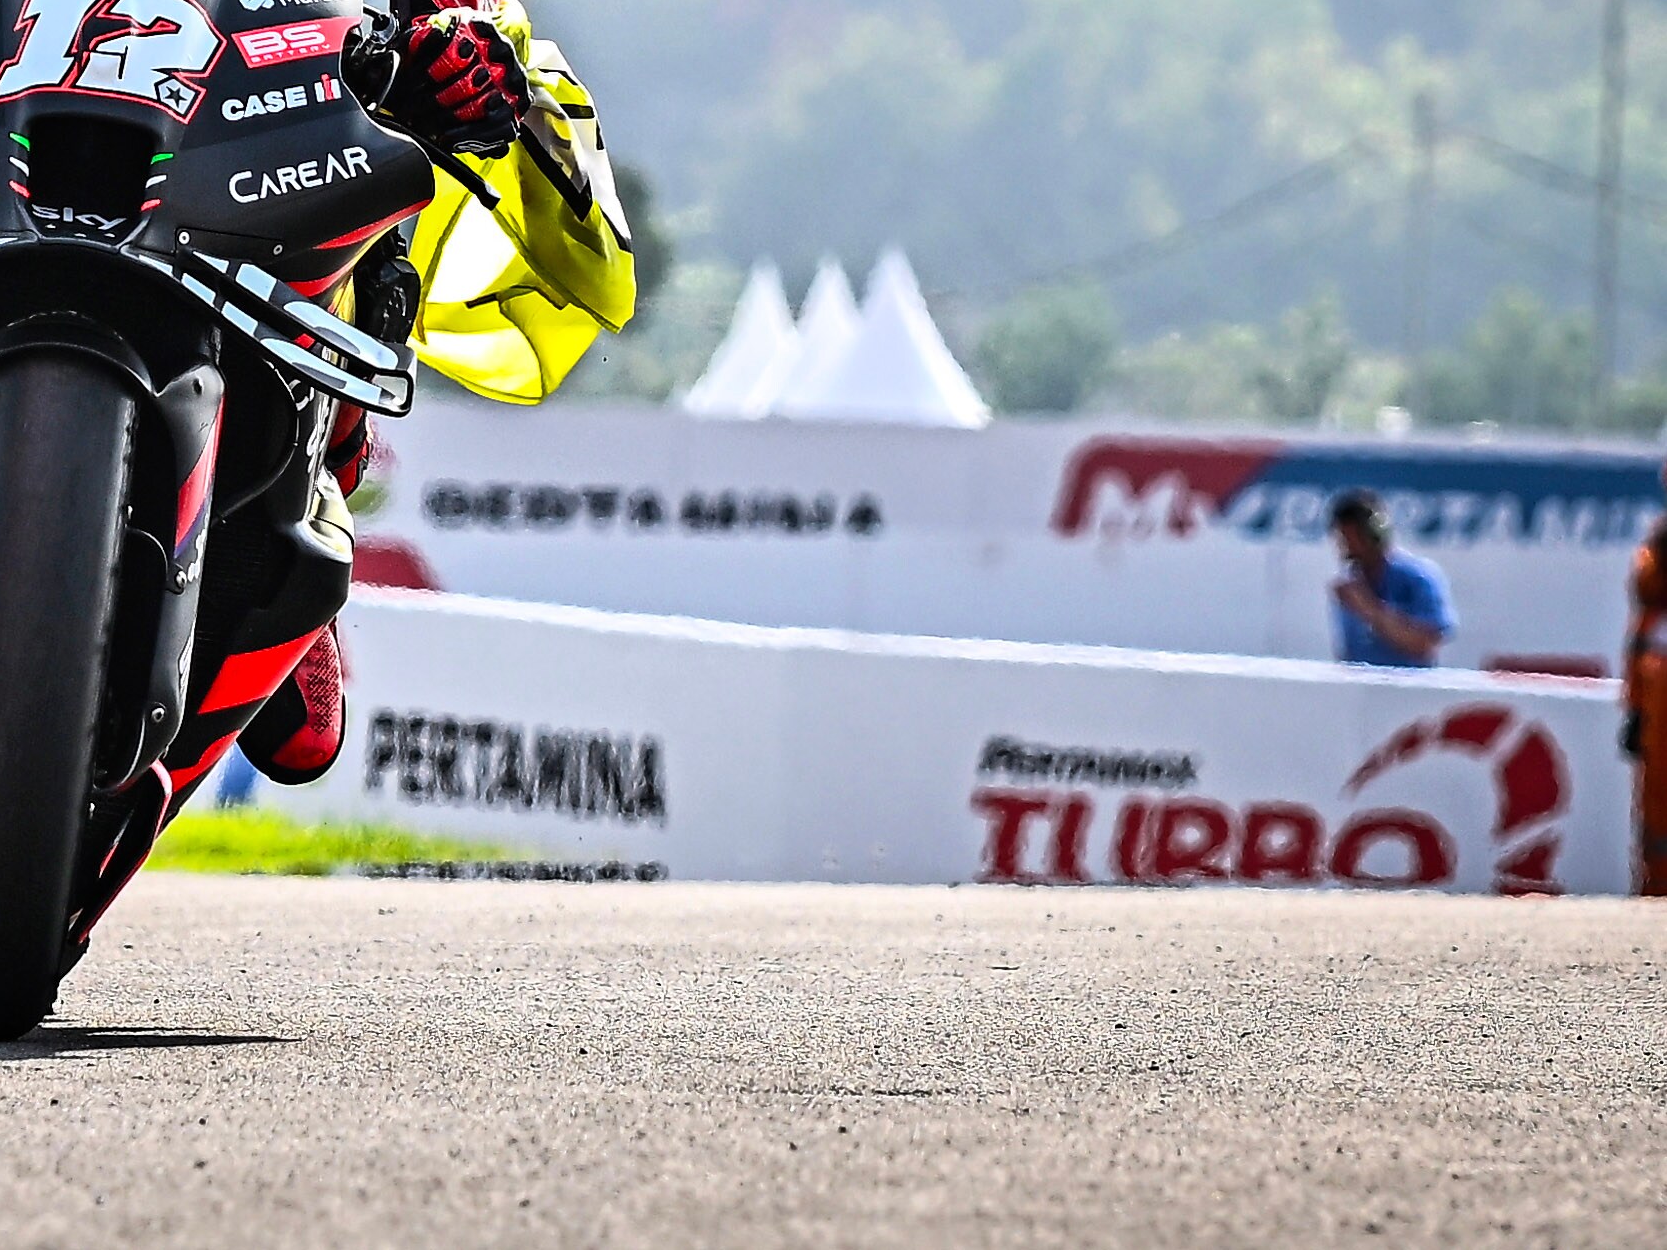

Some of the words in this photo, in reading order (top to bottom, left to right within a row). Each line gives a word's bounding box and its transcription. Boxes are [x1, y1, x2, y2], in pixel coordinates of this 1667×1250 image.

[239, 24, 326, 57] BS
[221, 85, 308, 121] CASE
[229, 146, 372, 203] CAREAR
[365, 710, 667, 828] PERTAMINA
[973, 788, 1457, 886] TURBO
